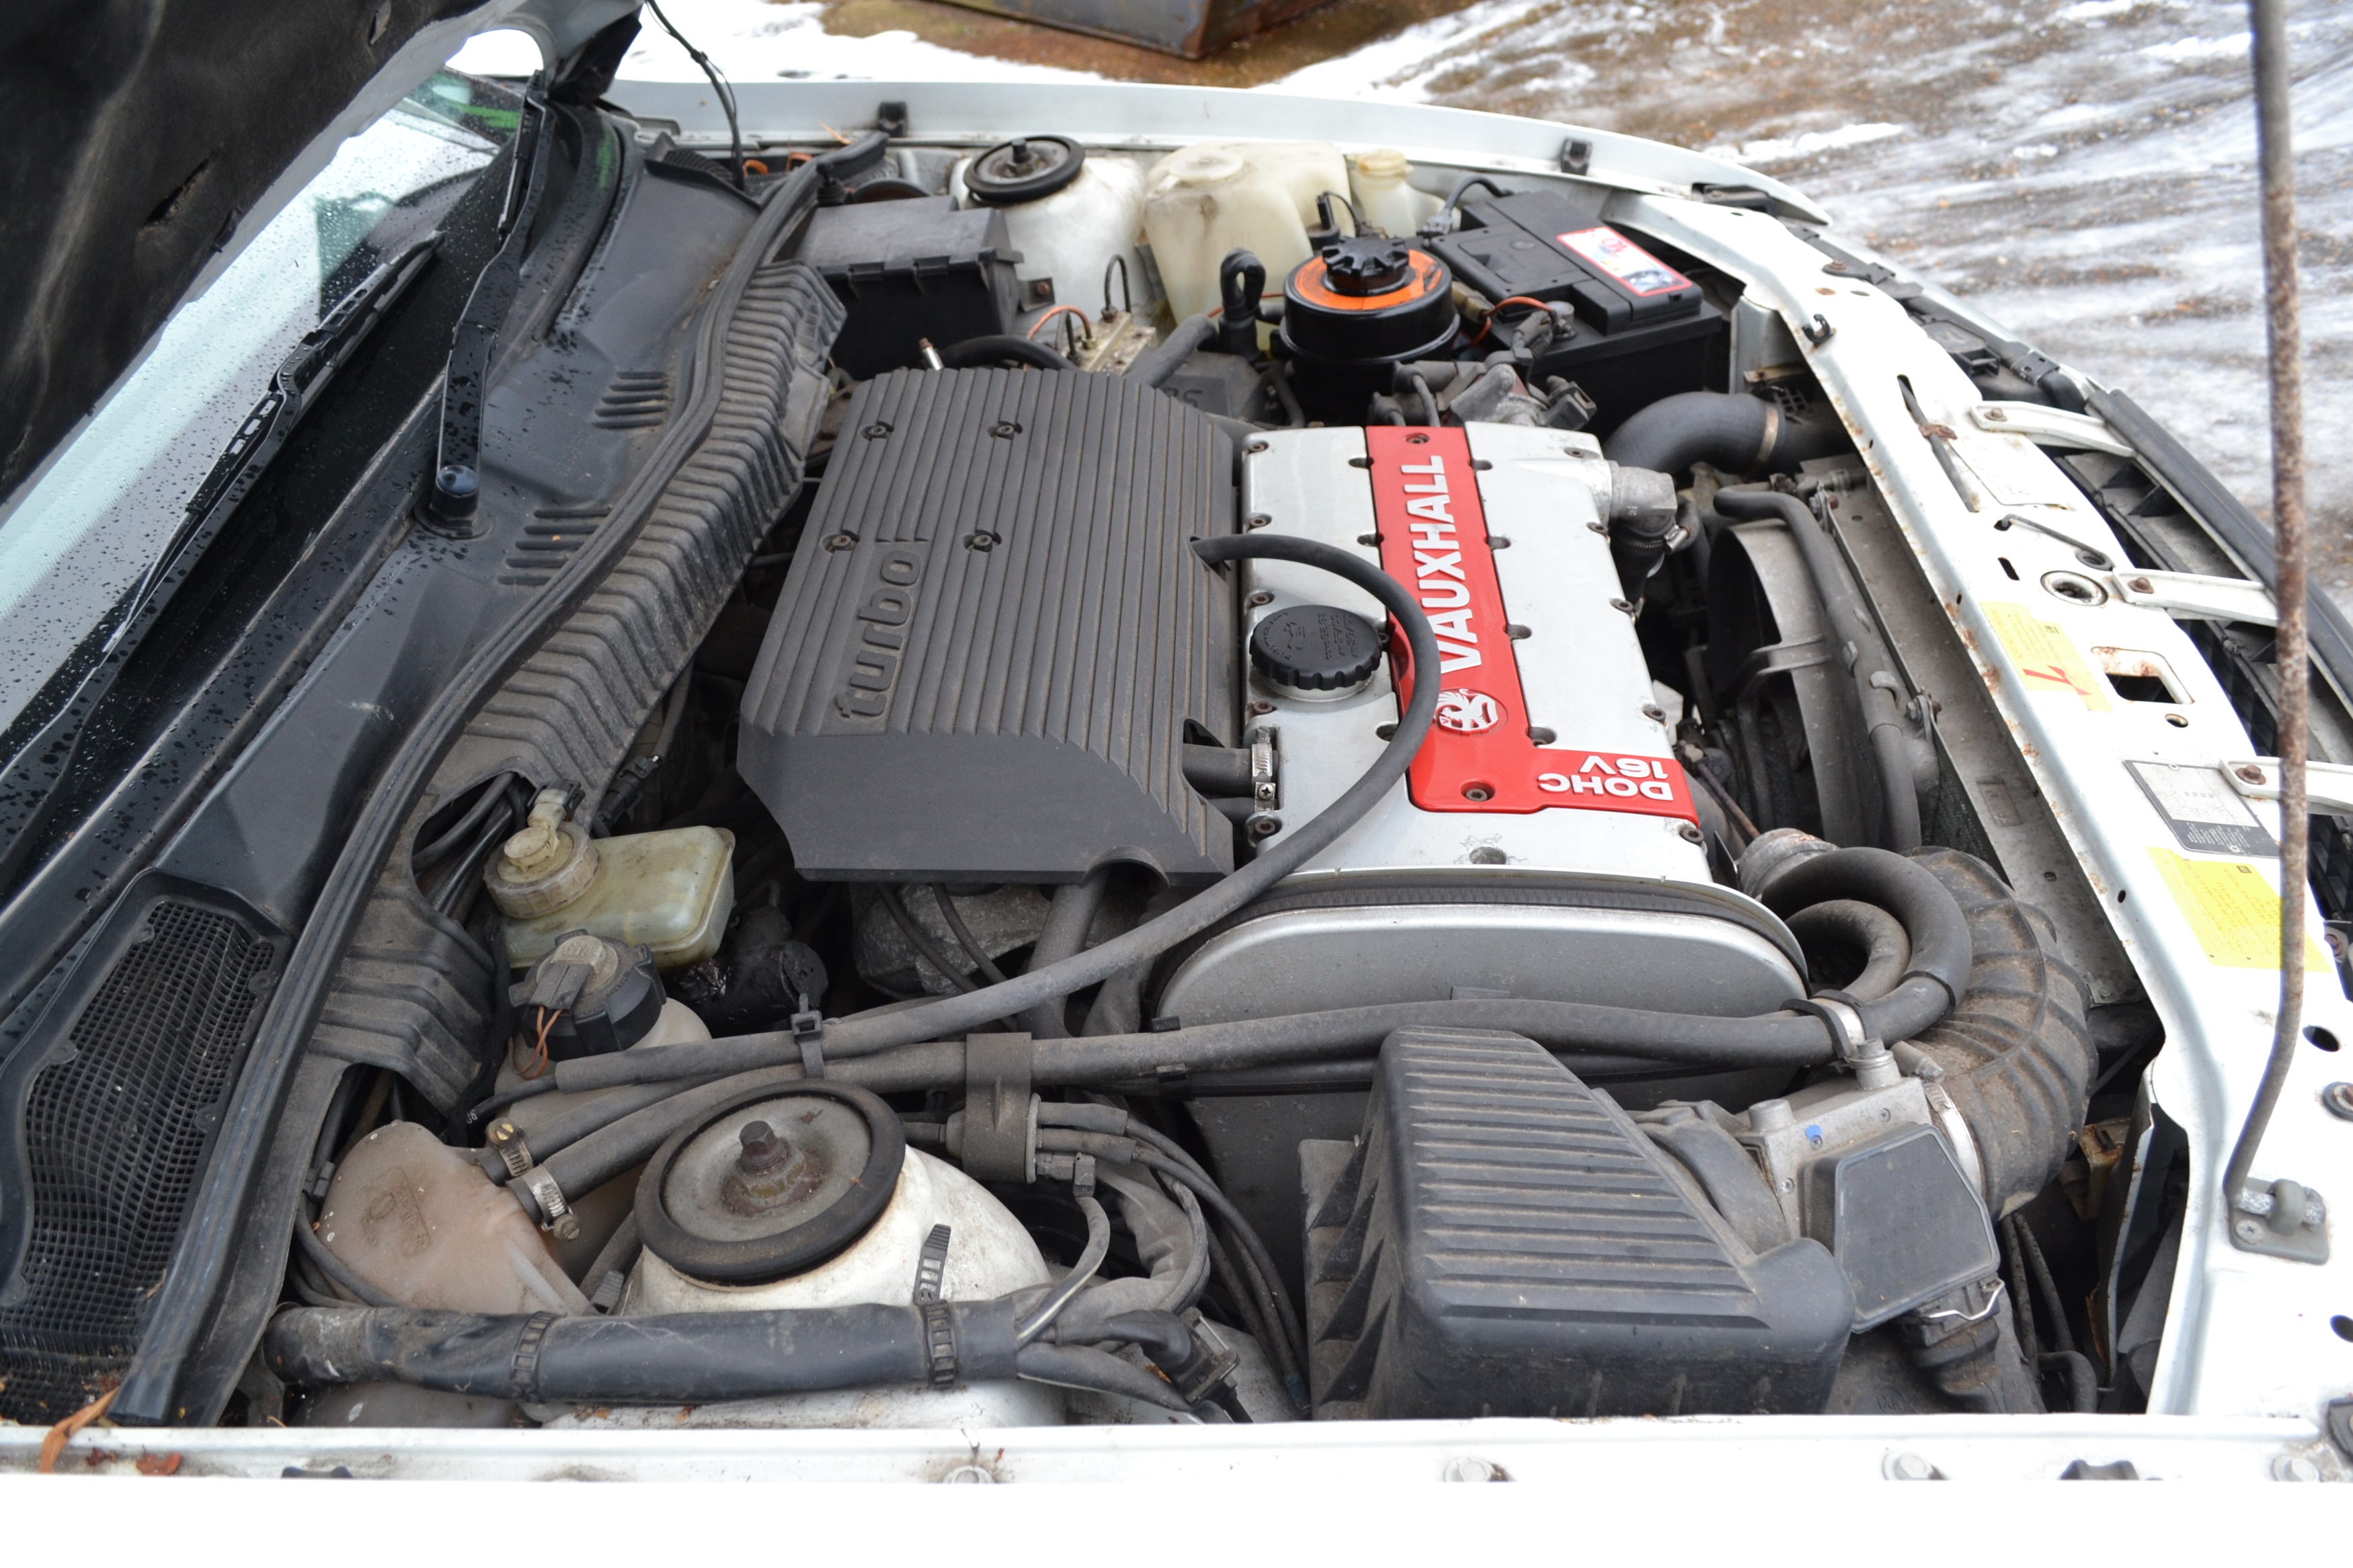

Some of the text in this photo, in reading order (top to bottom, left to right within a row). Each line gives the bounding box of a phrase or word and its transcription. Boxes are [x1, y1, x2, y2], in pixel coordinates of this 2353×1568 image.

[1400, 456, 1482, 674] VAUXHALL
[834, 550, 921, 718] turbo
[1537, 772, 1674, 800] DOHC
[1579, 755, 1669, 780] 16V
